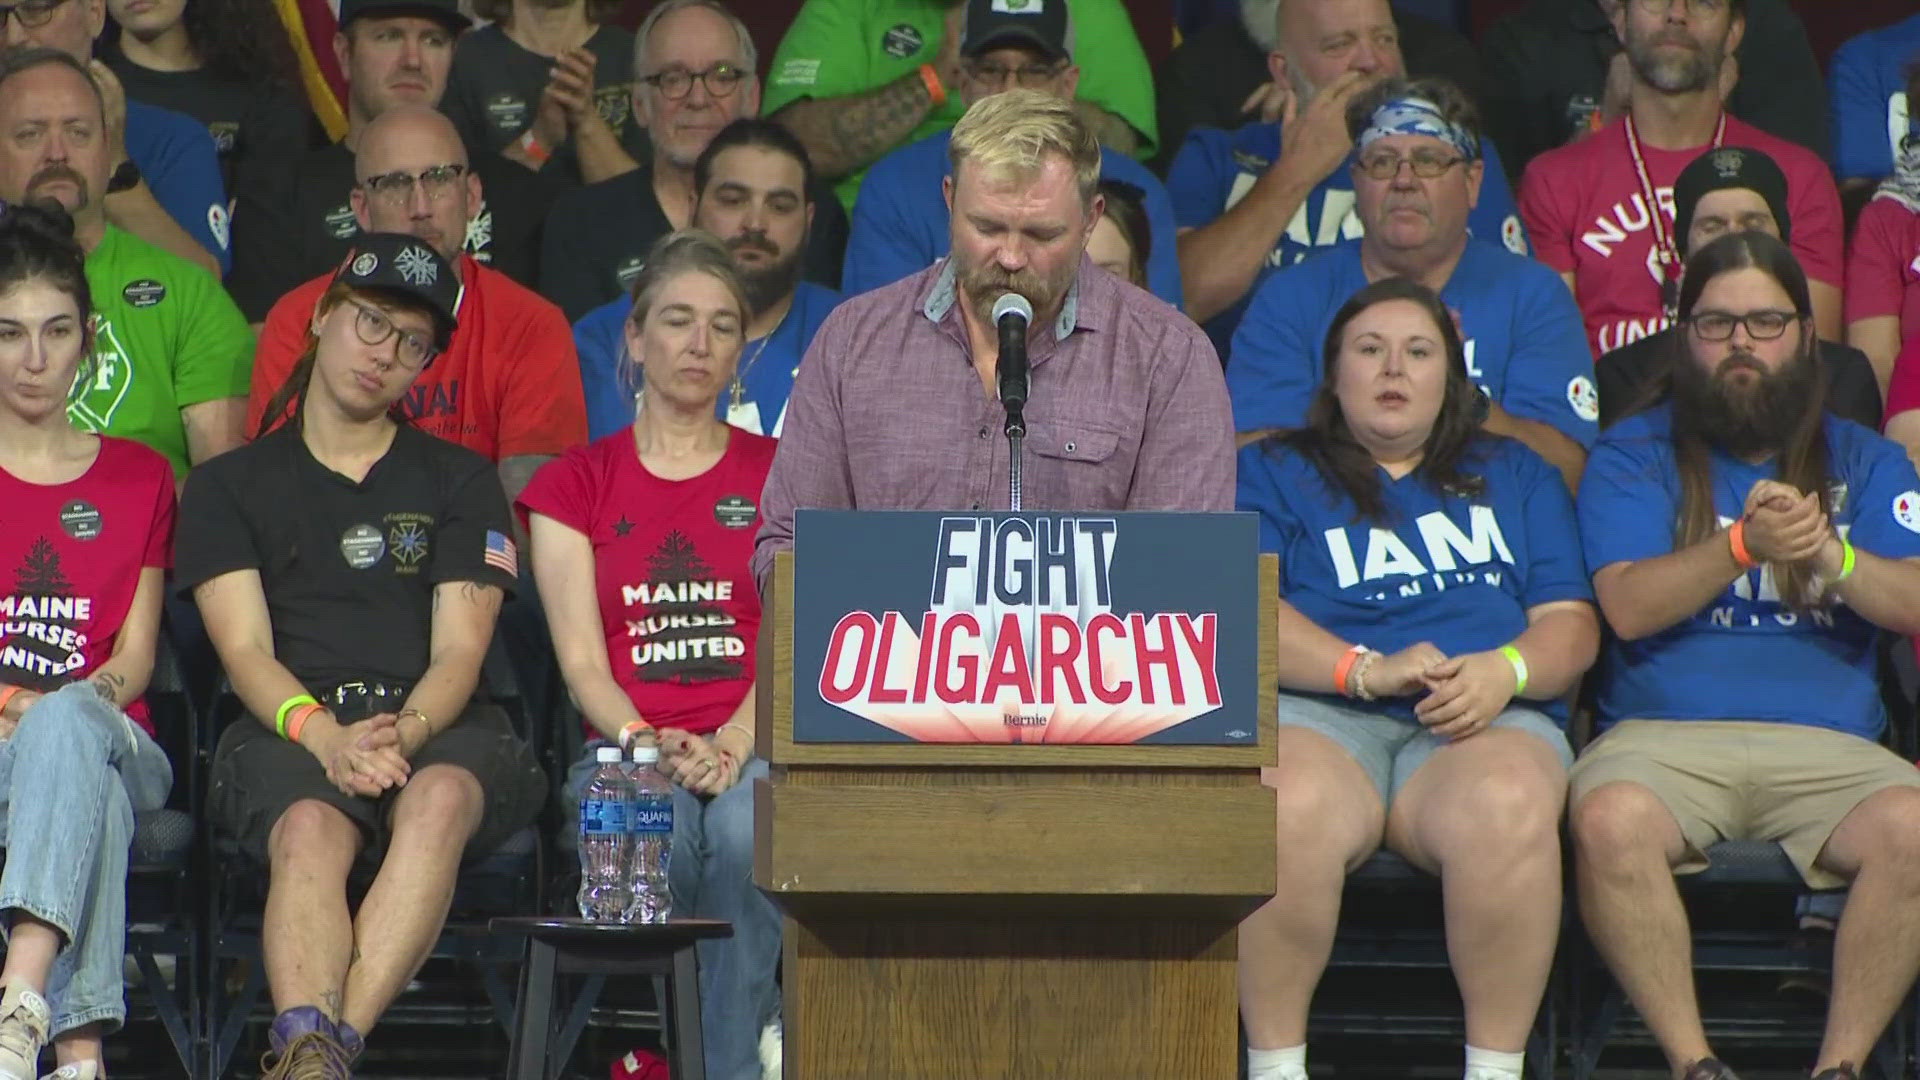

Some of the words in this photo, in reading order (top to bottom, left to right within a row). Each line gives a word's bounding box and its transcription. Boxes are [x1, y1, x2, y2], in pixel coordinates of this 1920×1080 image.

[73, 504, 84, 512] NO
[78, 522, 88, 530] NO
[357, 529, 368, 537] NO
[358, 549, 369, 557] NO
[1324, 505, 1515, 589] IAM
[931, 517, 1117, 608] FIGHT
[621, 580, 734, 606] MAINE
[0, 645, 86, 677] NITED
[631, 636, 746, 666] UNITED
[818, 611, 1223, 707] OLIGARCHY
[1002, 713, 1047, 727] Bernie
